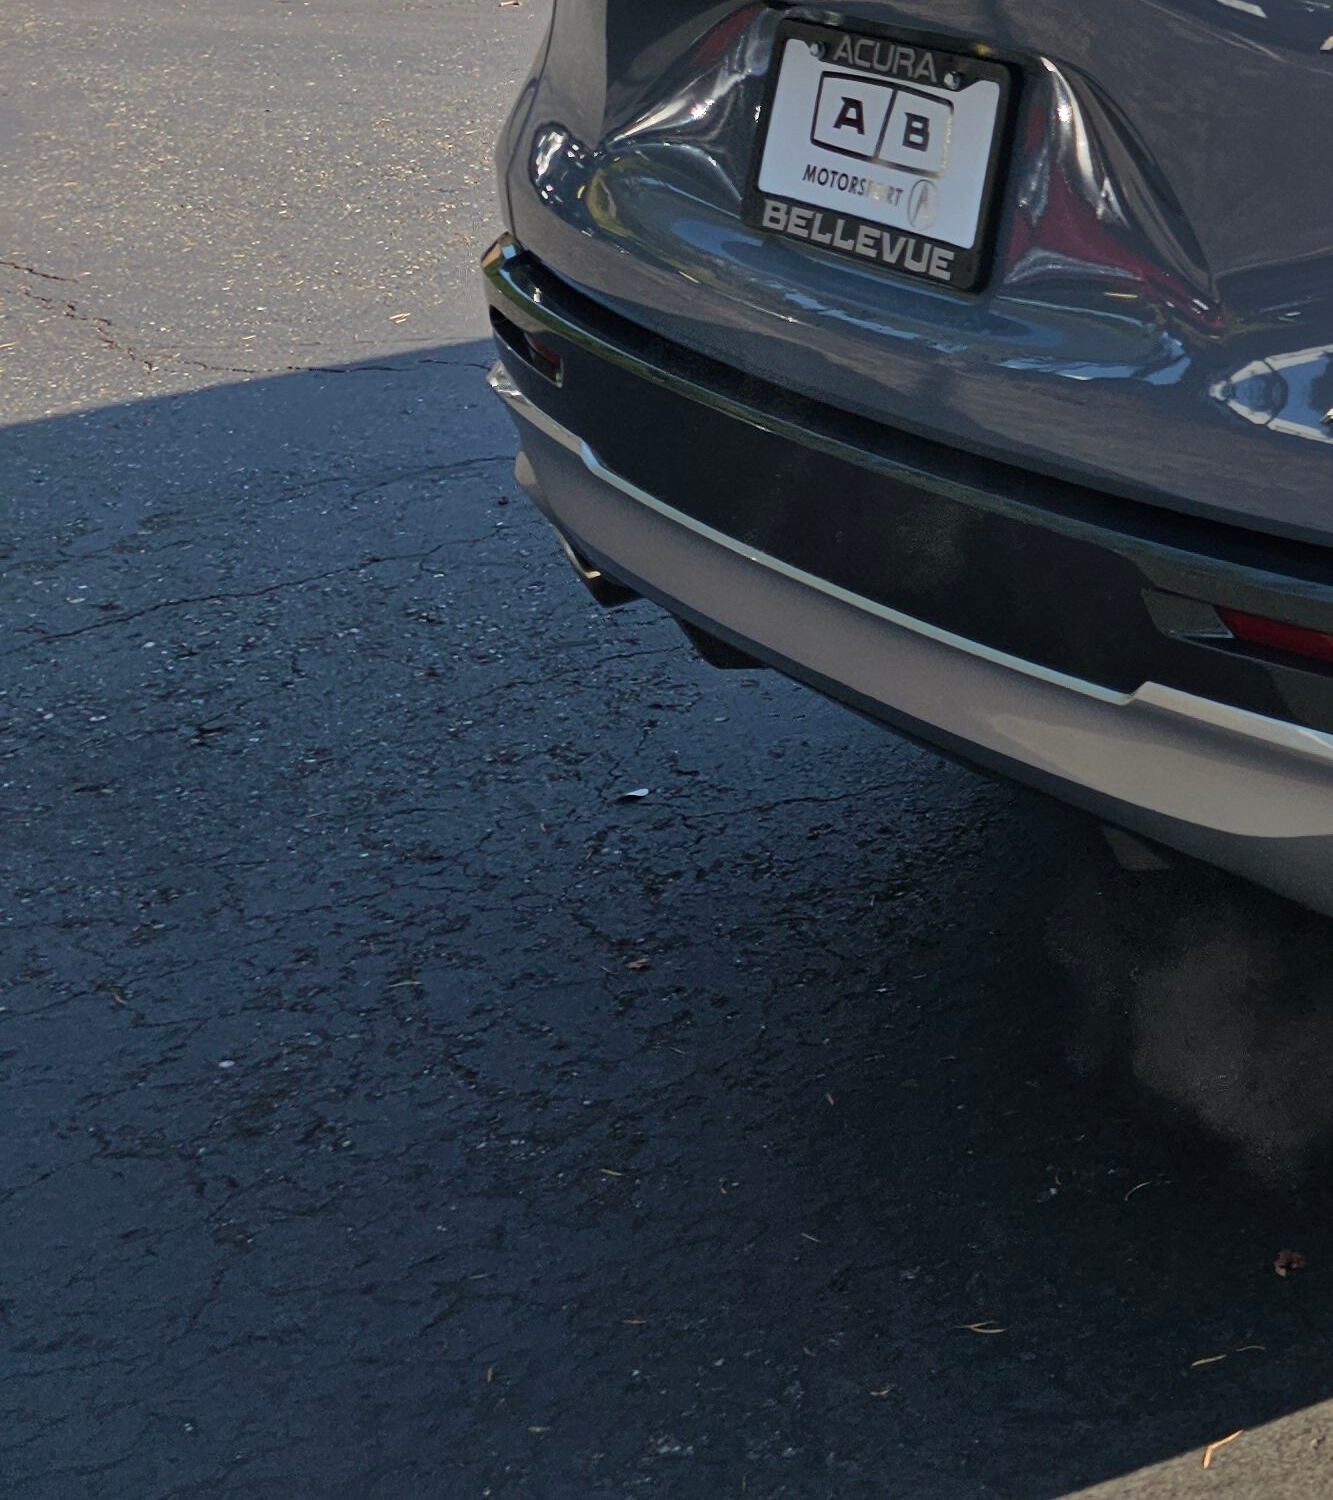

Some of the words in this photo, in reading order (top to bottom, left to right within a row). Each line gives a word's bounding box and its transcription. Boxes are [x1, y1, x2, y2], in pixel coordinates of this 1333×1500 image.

[832, 34, 938, 83] ACURA
[832, 96, 866, 136] A
[901, 111, 931, 152] B
[802, 164, 904, 208] MOTORSRT
[761, 199, 955, 281] BELLEVUE
